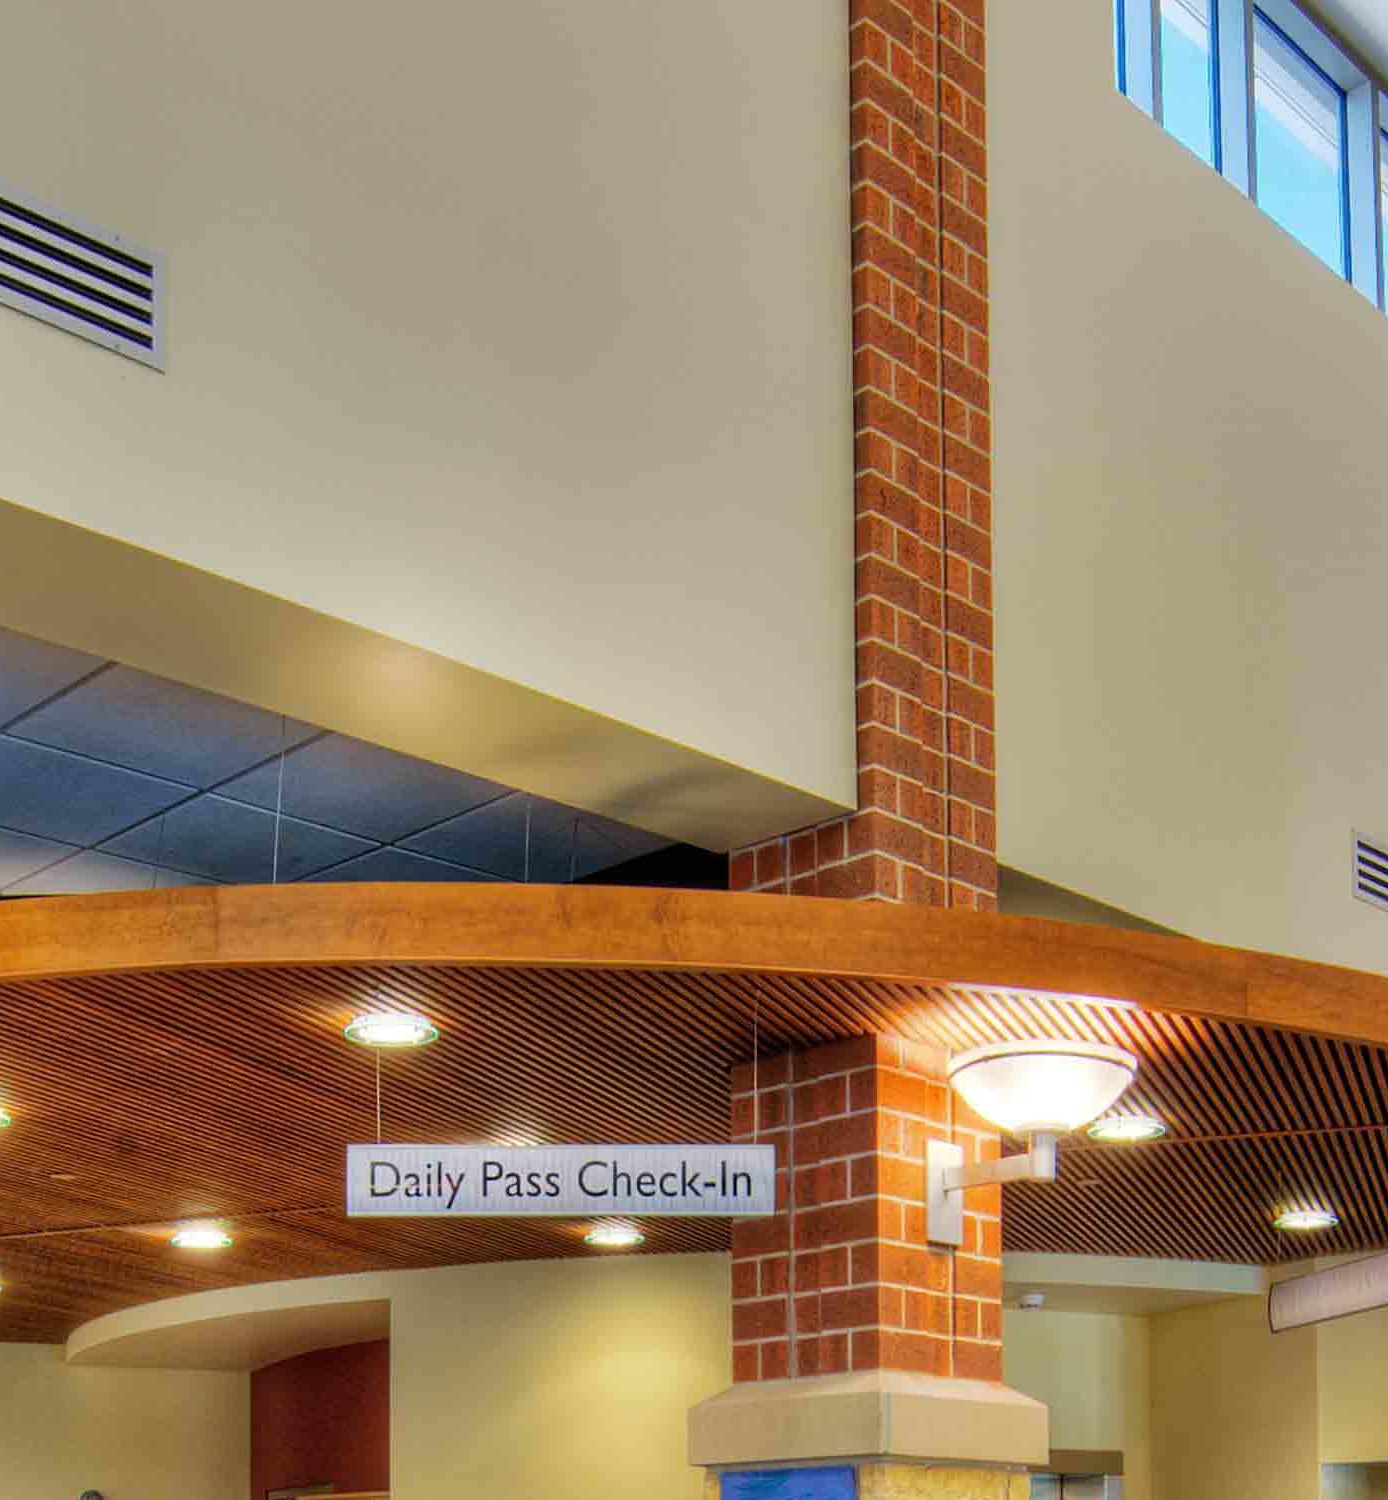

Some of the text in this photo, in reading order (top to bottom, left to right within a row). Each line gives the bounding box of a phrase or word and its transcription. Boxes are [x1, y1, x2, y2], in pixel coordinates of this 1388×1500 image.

[368, 1160, 753, 1210] Daily Pass Check-In
